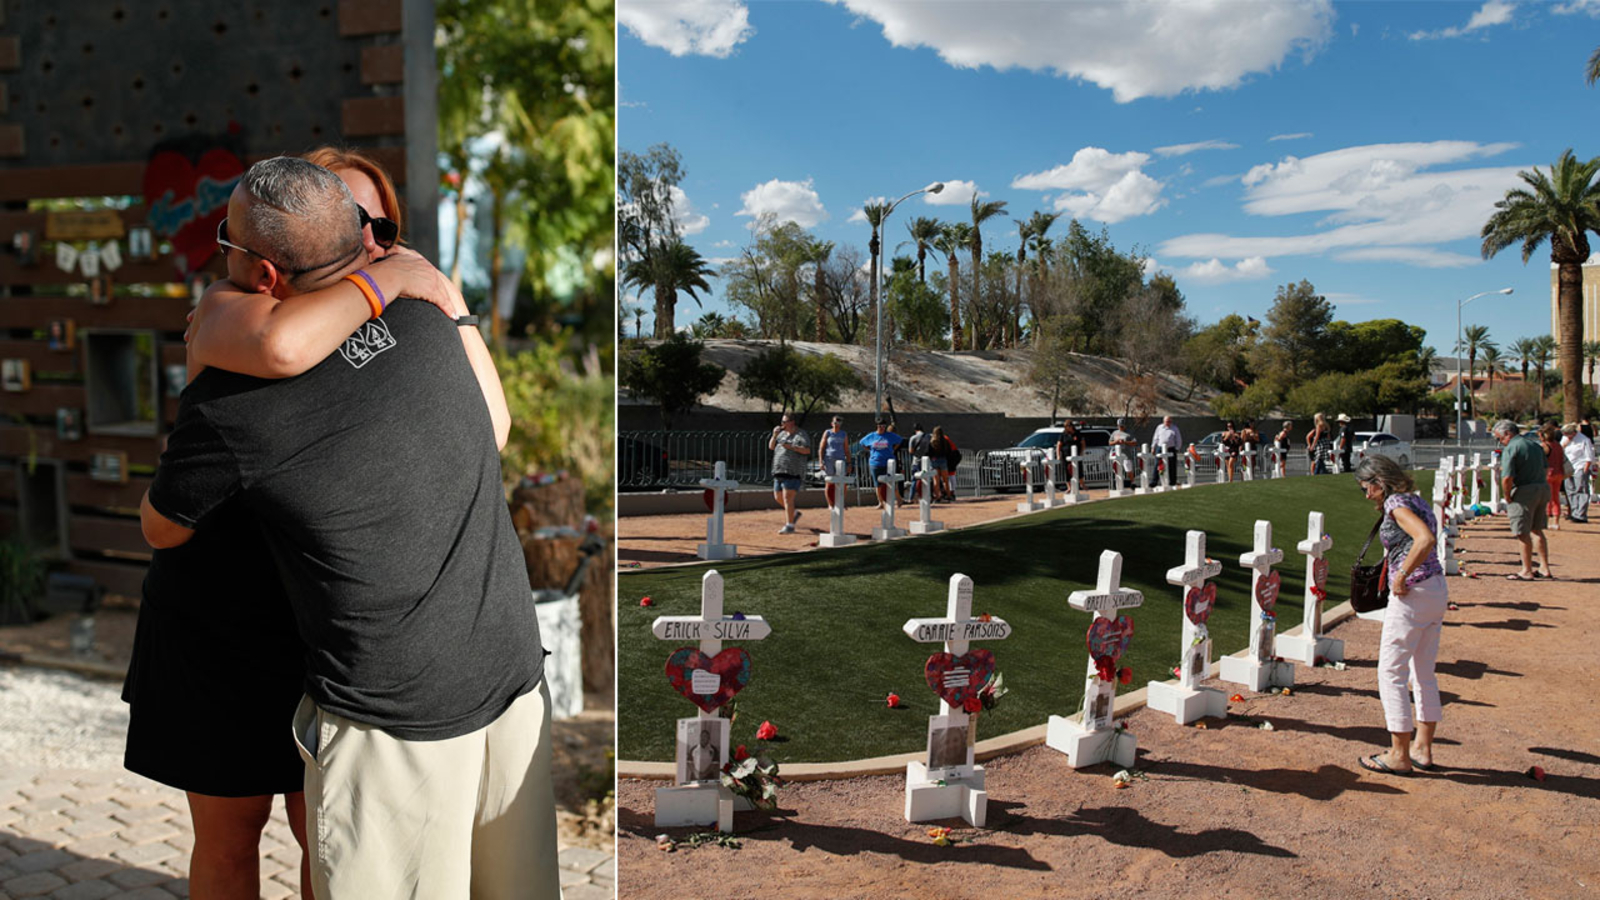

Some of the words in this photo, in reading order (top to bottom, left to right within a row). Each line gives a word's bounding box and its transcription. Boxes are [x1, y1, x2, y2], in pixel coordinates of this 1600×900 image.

[664, 621, 701, 639] ERICK
[713, 621, 751, 640] SILVA
[918, 623, 956, 641] CARRIE
[963, 622, 1007, 640] PARSONS
